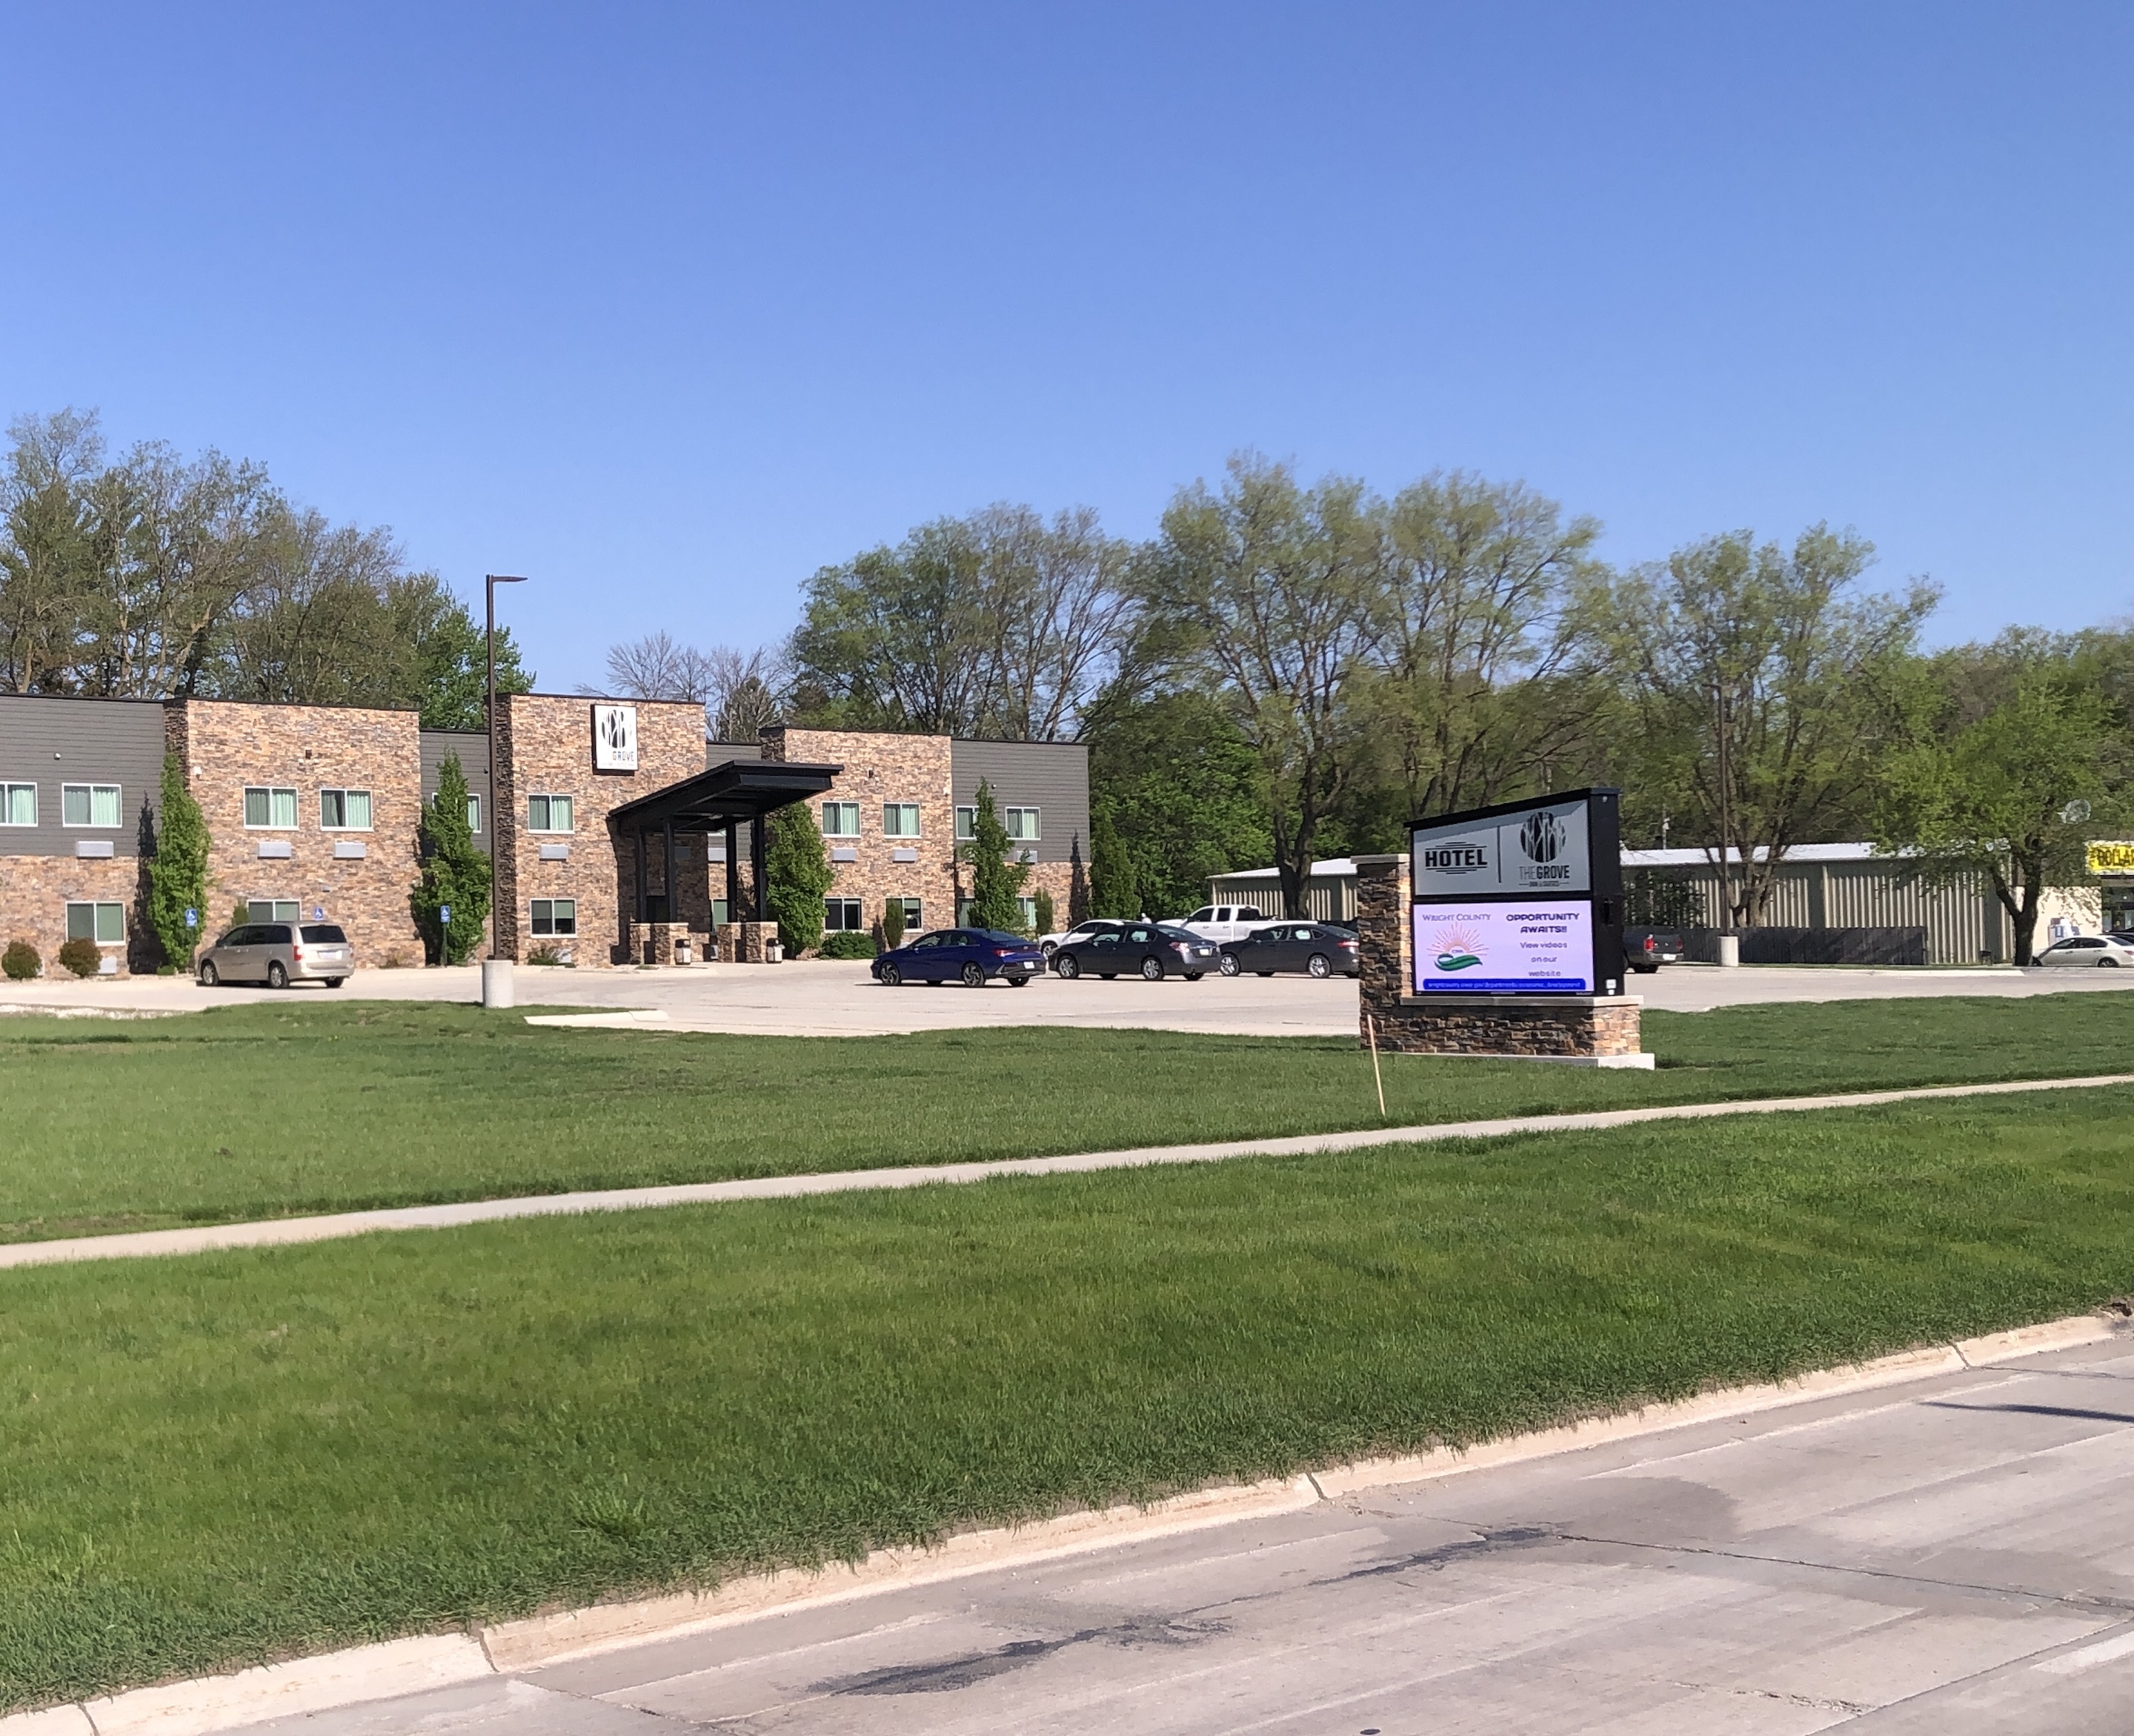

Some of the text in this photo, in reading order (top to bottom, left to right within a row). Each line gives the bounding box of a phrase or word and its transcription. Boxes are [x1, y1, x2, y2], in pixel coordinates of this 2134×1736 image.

[1425, 849, 1488, 867] HOTEL
[2097, 848, 2134, 866] DOLLA
[1519, 865, 1570, 879] THE GROVE
[1456, 913, 1492, 921] COUNTY
[1506, 913, 1580, 921] OPPORTUNITY
